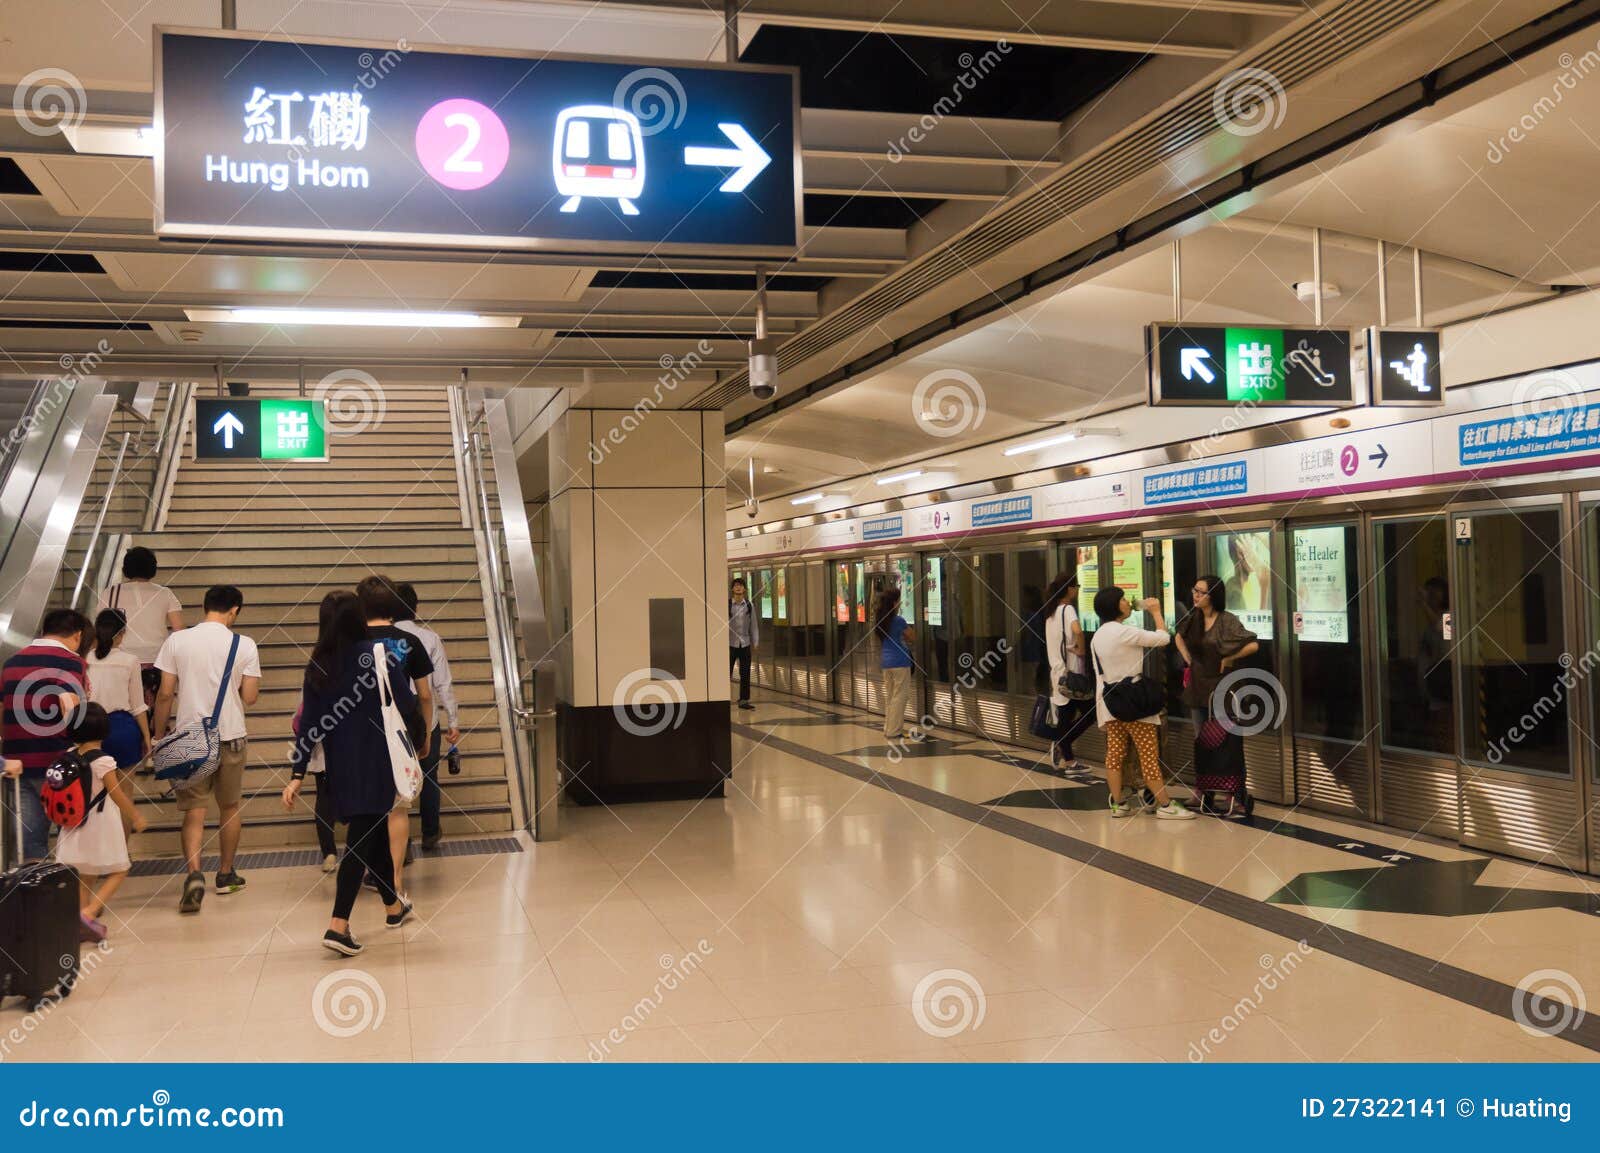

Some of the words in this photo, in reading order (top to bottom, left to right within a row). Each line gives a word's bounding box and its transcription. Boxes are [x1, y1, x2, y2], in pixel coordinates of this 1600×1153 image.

[243, 87, 371, 151] 紅磡
[444, 112, 483, 172] 2
[206, 155, 289, 192] Hung
[298, 158, 369, 188] Hom
[1238, 342, 1272, 375] 出
[1240, 376, 1272, 388] EXIT
[277, 411, 308, 437] 出
[278, 439, 307, 449] EXIT
[1345, 450, 1354, 471] 2
[1460, 522, 1467, 535] 2
[1309, 545, 1338, 560] Healer
